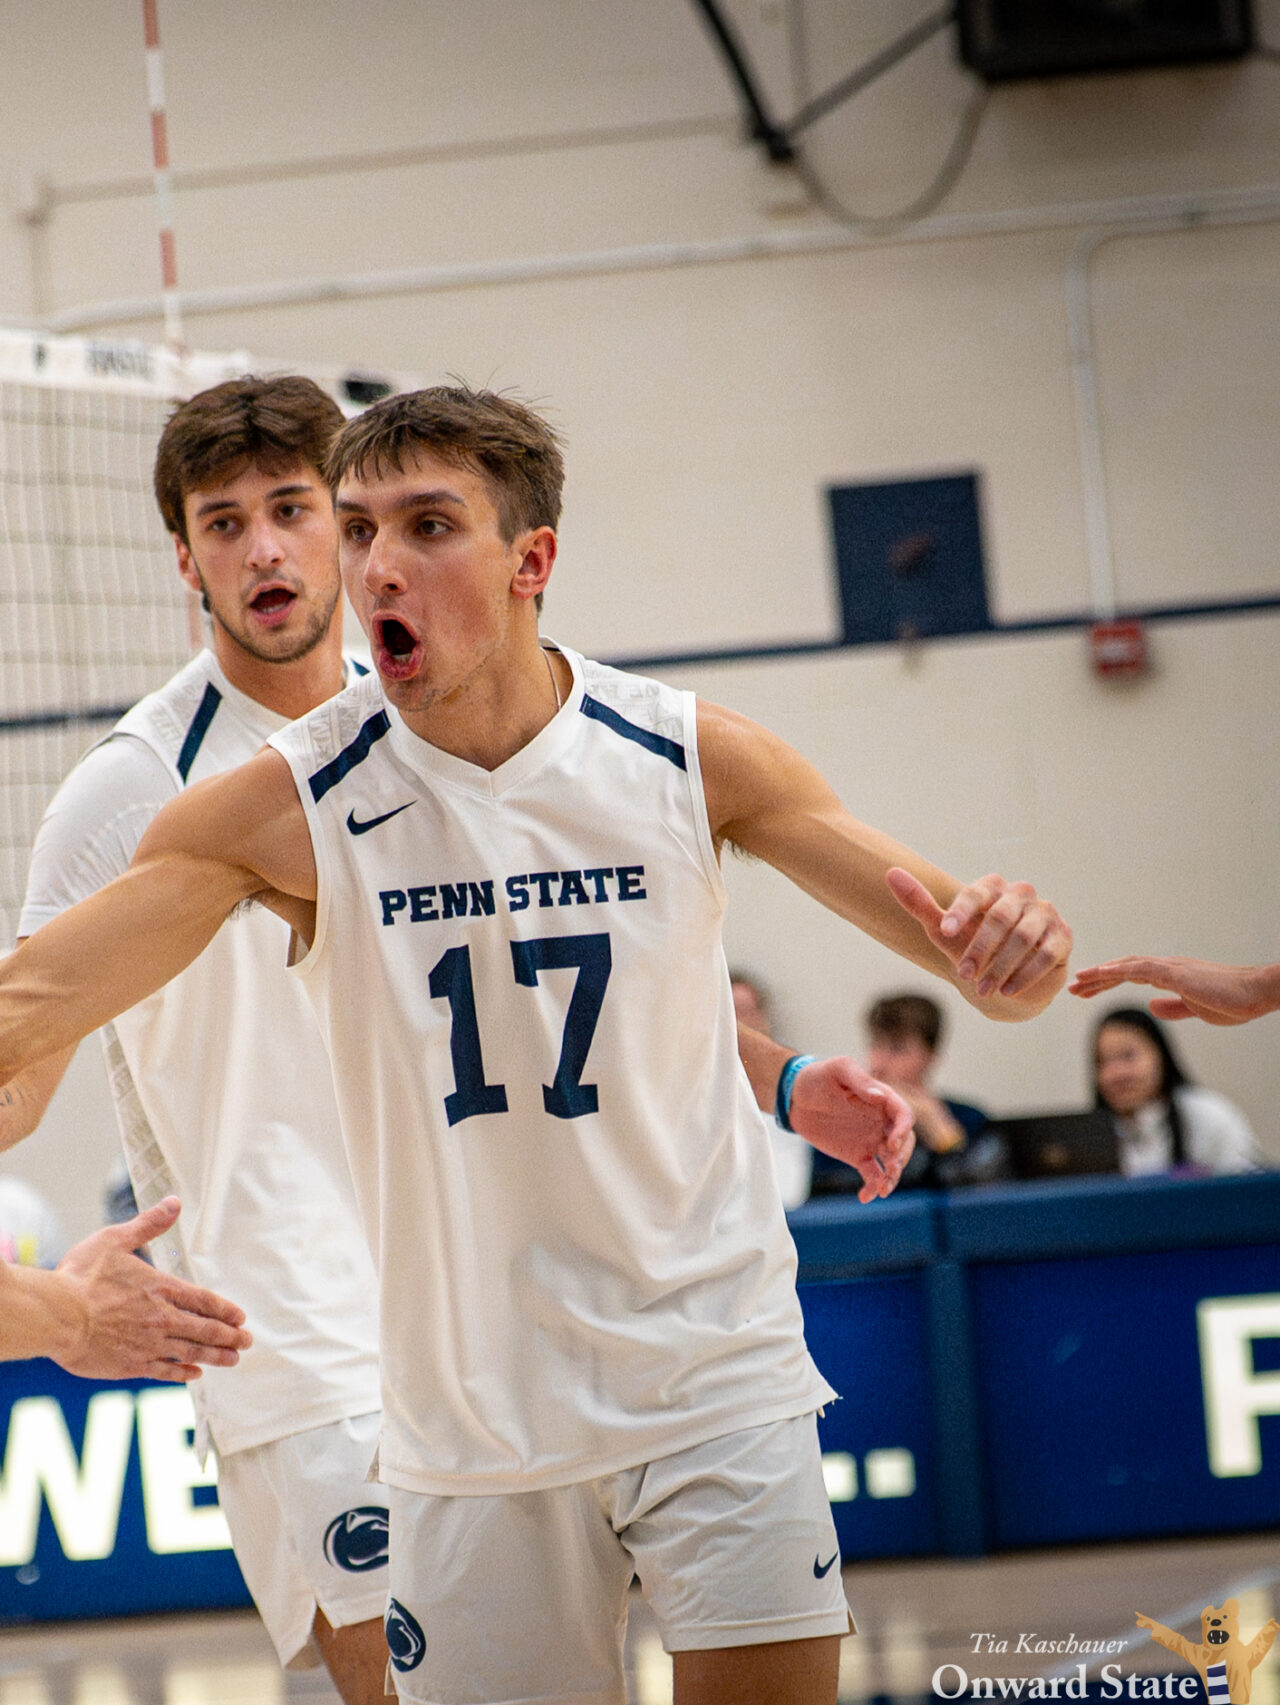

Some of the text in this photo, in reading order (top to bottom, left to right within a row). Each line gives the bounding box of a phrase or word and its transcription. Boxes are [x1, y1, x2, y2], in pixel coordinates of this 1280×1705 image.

[379, 866, 648, 926] PENN STATE
[428, 932, 612, 1127] 17
